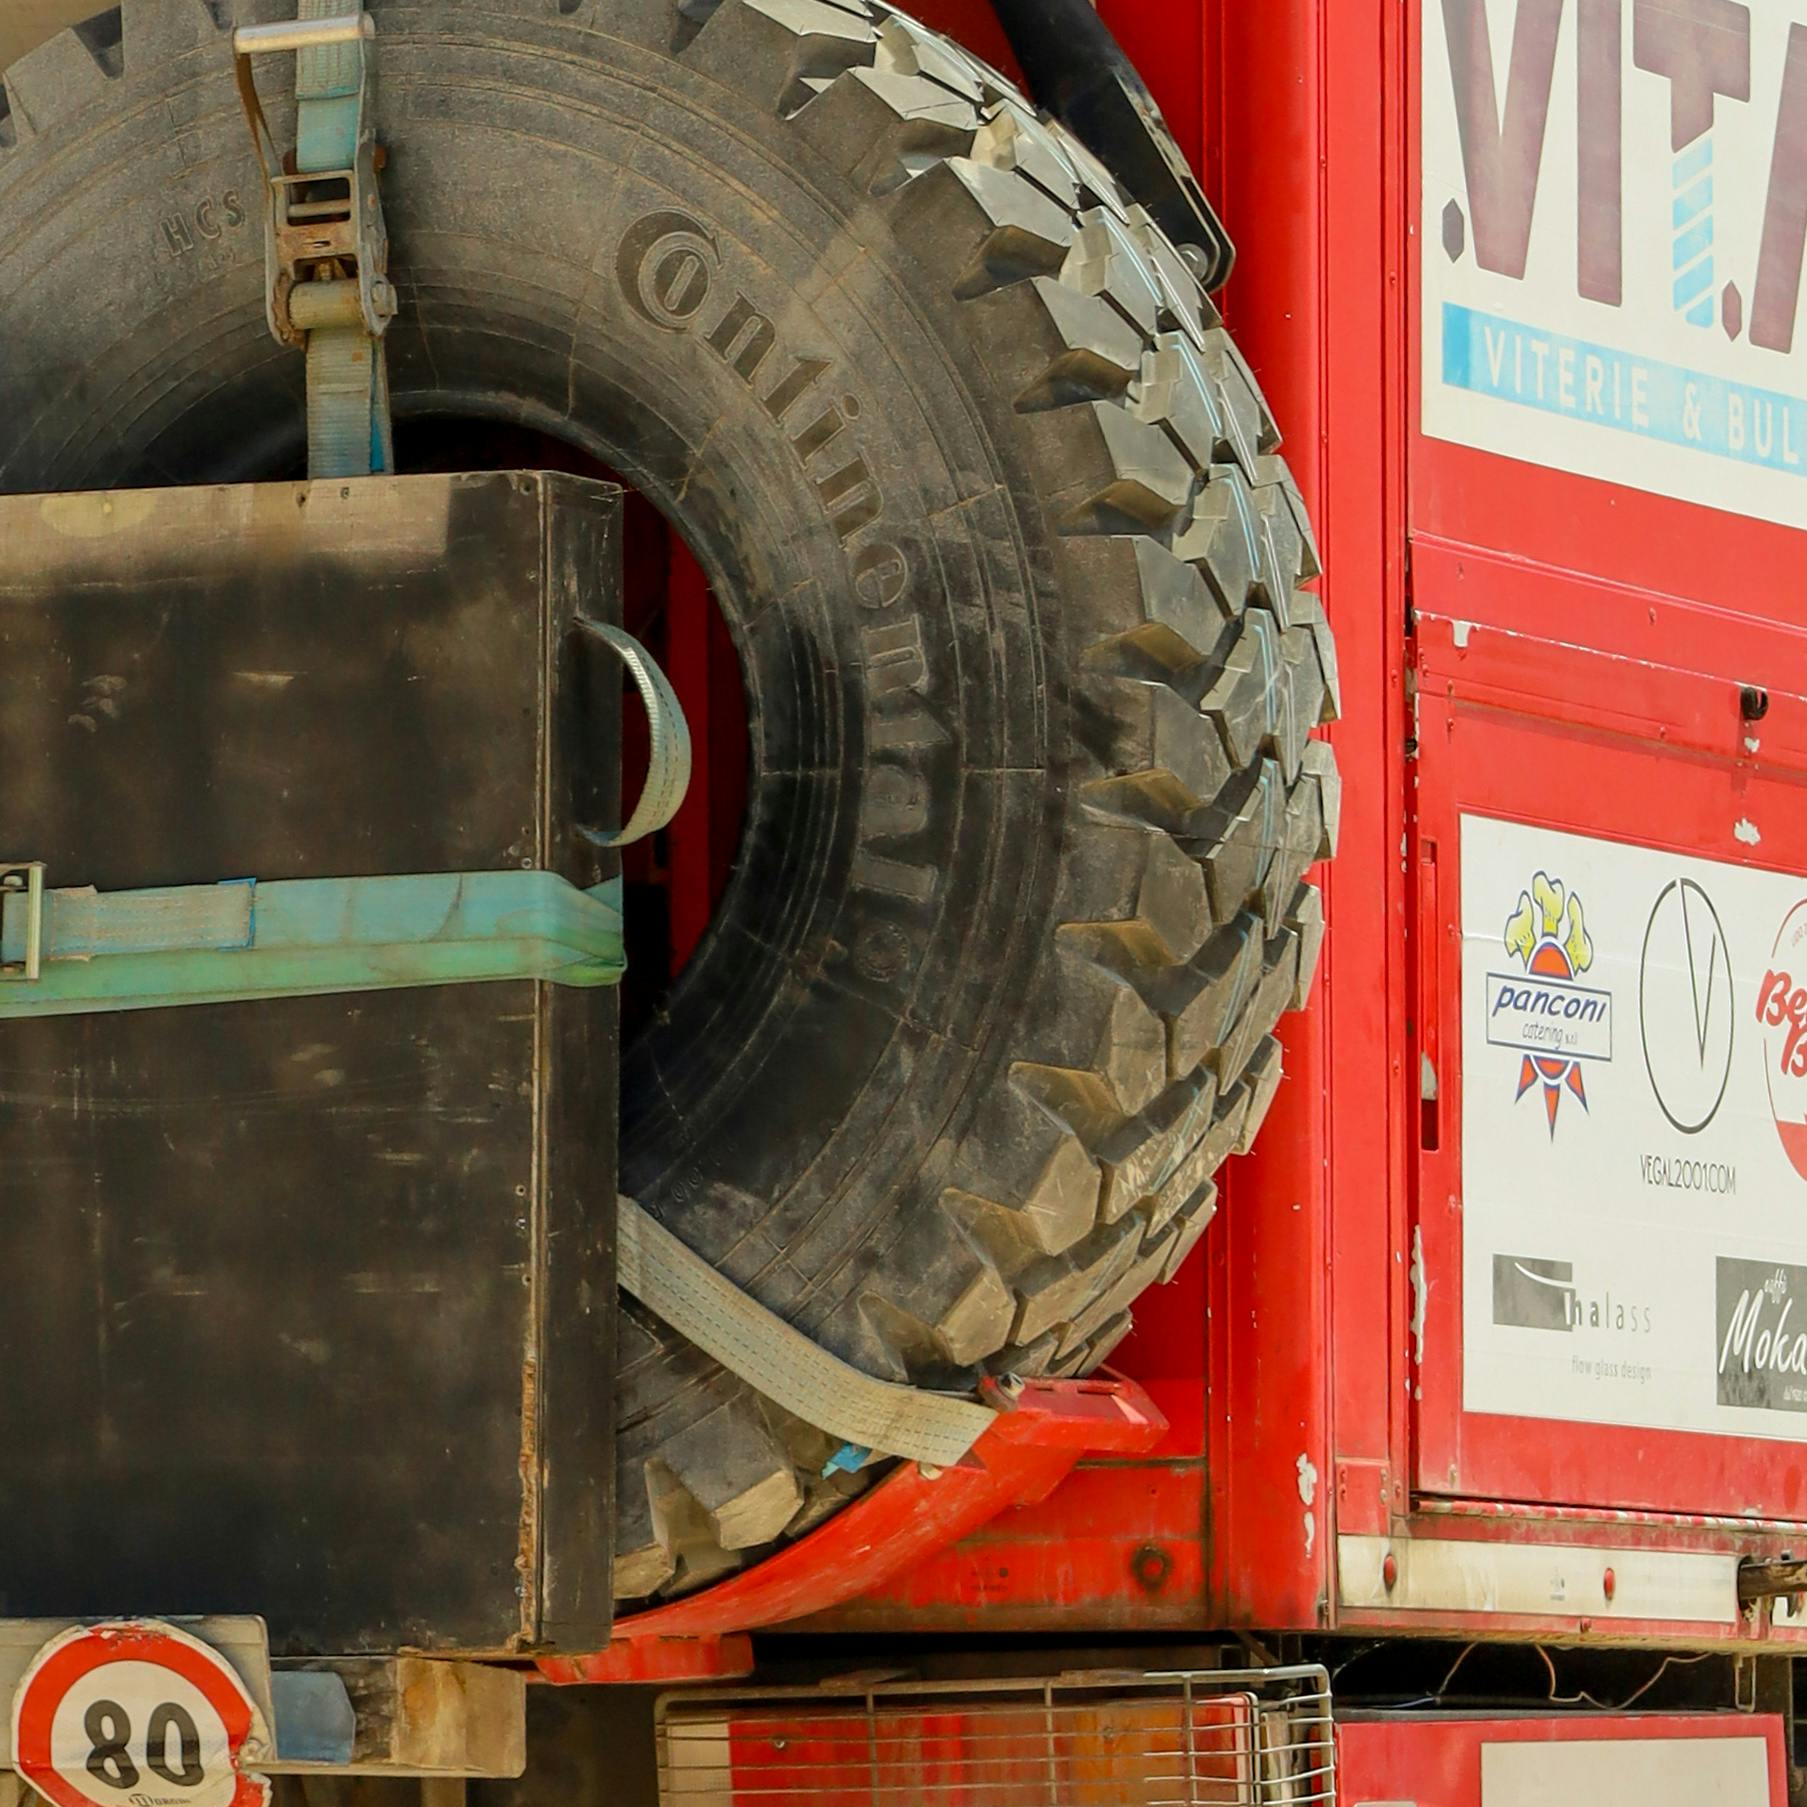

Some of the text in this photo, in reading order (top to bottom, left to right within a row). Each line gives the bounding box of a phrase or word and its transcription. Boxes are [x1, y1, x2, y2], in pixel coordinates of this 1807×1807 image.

[1484, 325, 1650, 431] VITERIE
[1682, 389, 1703, 441] &
[1492, 985, 1607, 1023] panconi
[1522, 1022, 1563, 1050] catering
[84, 1699, 205, 1790] 80
